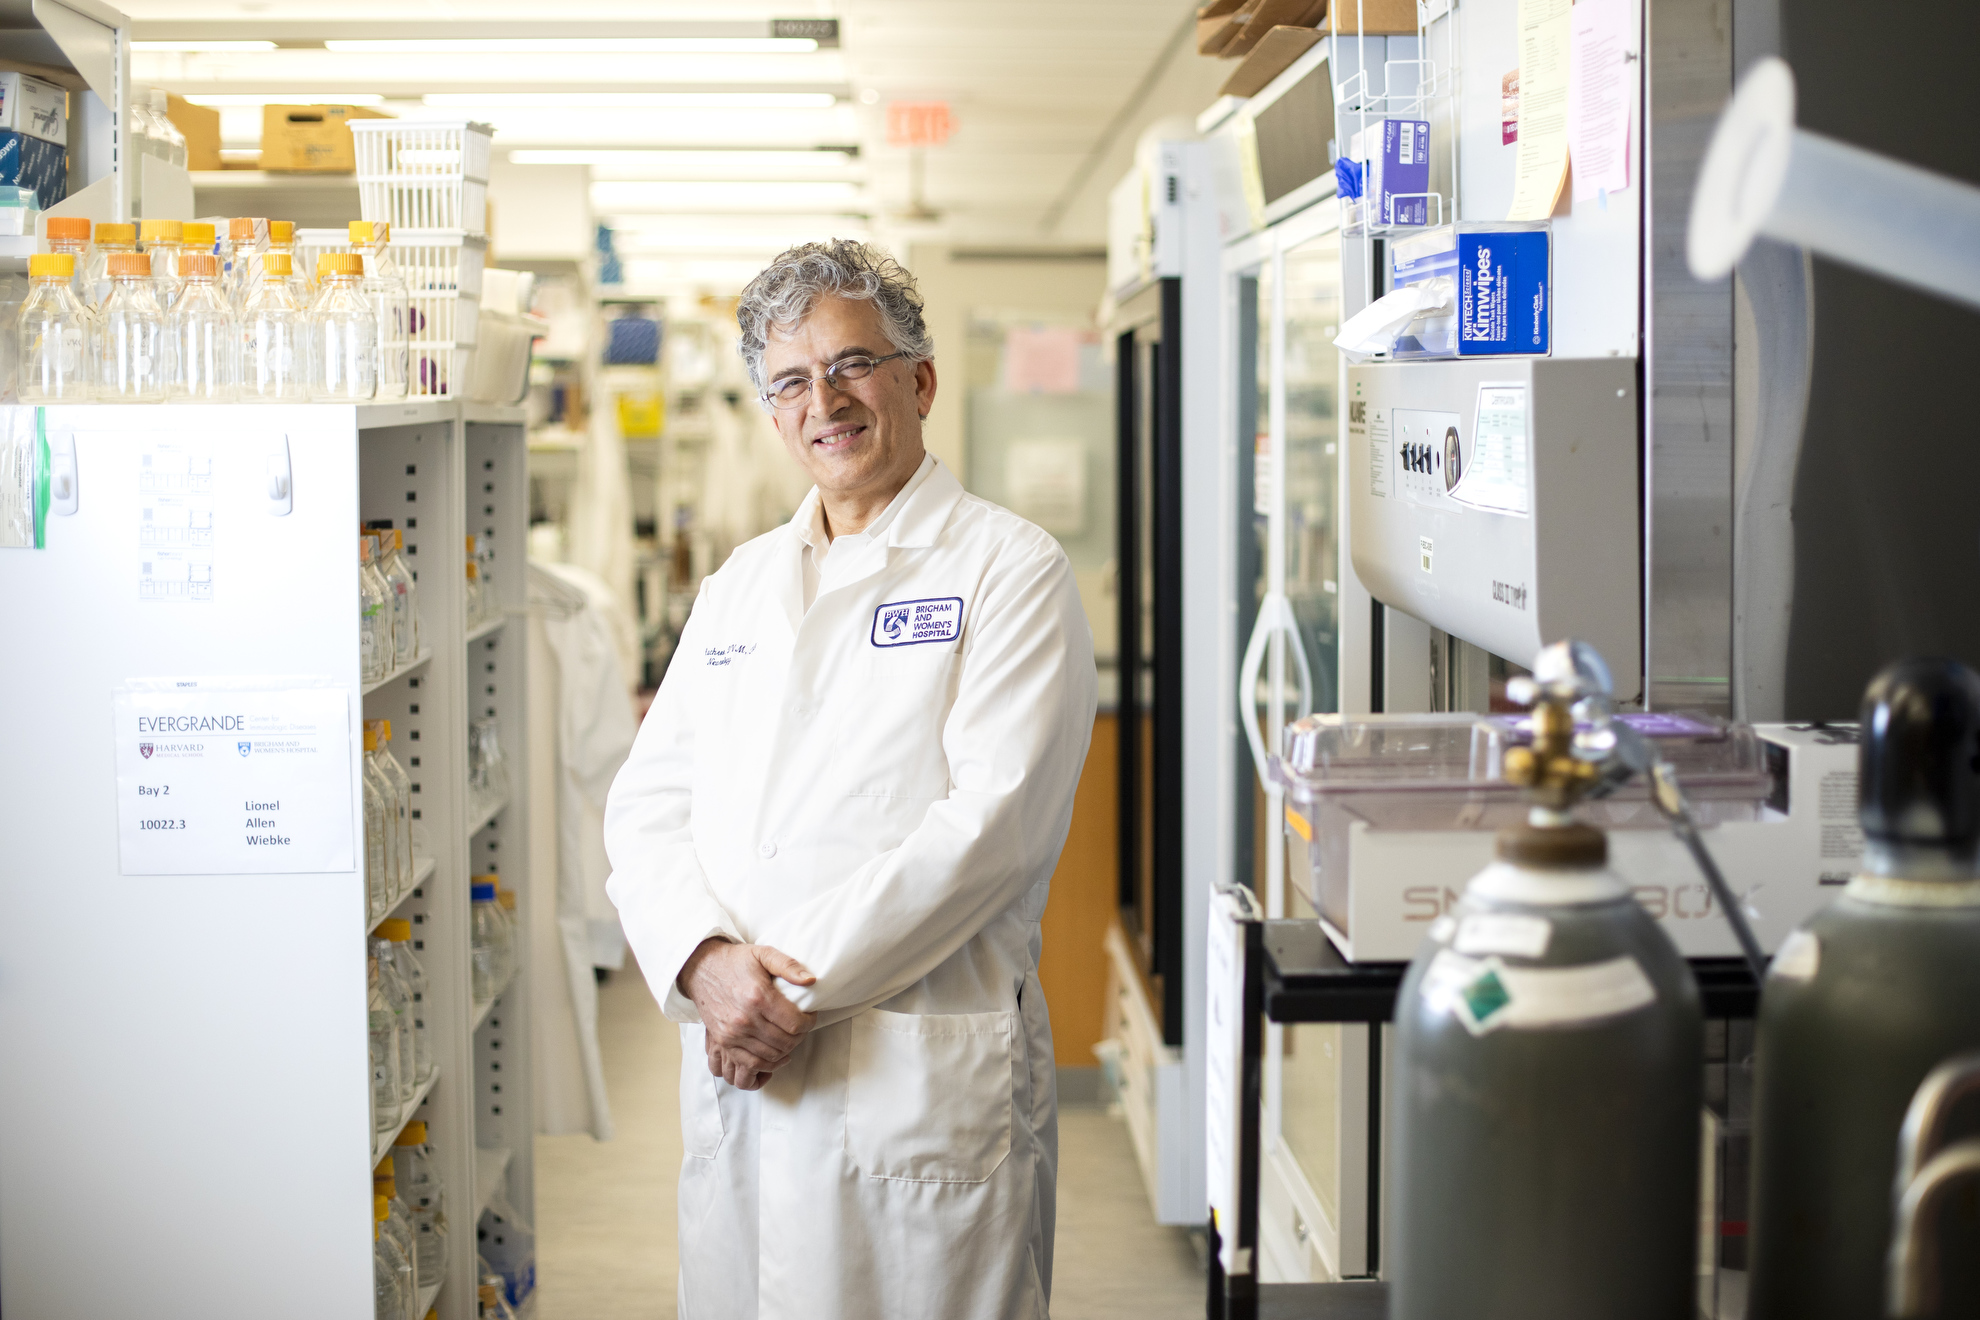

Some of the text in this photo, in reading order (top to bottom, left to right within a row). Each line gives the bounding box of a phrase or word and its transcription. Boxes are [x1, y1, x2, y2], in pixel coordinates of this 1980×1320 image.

[1472, 248, 1494, 341] Kimwipes
[1464, 295, 1473, 341] KIMTECH
[916, 604, 952, 613] BRIGHAM
[914, 613, 932, 622] AND
[913, 621, 952, 630] WOMEN'S
[912, 629, 951, 639] HOSPITAL
[271, 714, 280, 722] for
[139, 715, 245, 732] EVERGRANDE
[249, 723, 287, 732] Immunologic
[156, 744, 204, 752] HARVARD
[138, 785, 170, 798] Bay 2
[245, 800, 280, 811] Lionel
[140, 819, 186, 830] 10022.3
[245, 818, 276, 828] Allen
[246, 835, 291, 845] Wiebke
